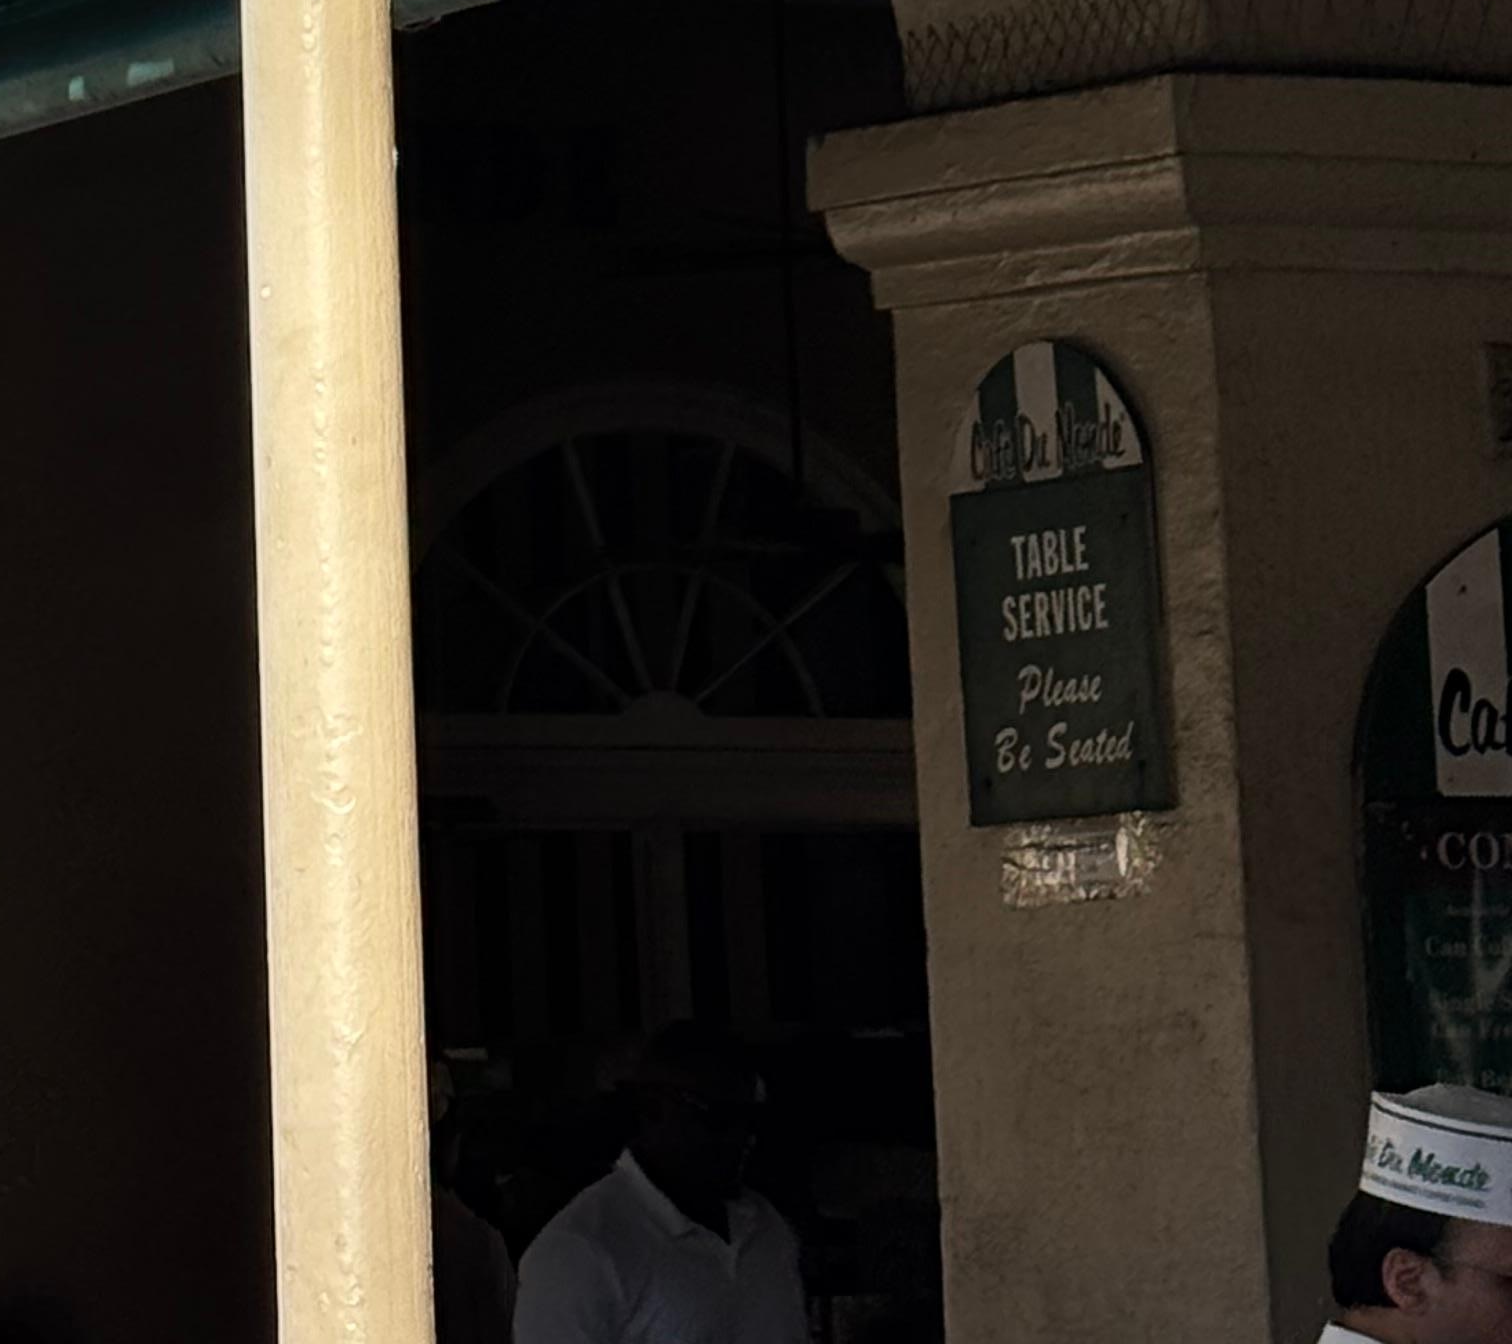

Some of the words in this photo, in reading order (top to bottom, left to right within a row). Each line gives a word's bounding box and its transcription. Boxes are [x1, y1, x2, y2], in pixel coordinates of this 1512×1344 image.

[1017, 414, 1051, 472] Du
[1010, 525, 1089, 581] TABLE
[1001, 582, 1110, 642] SERVICE
[1017, 663, 1102, 715] Please
[994, 726, 1032, 774] Be
[1044, 720, 1134, 770] Seated
